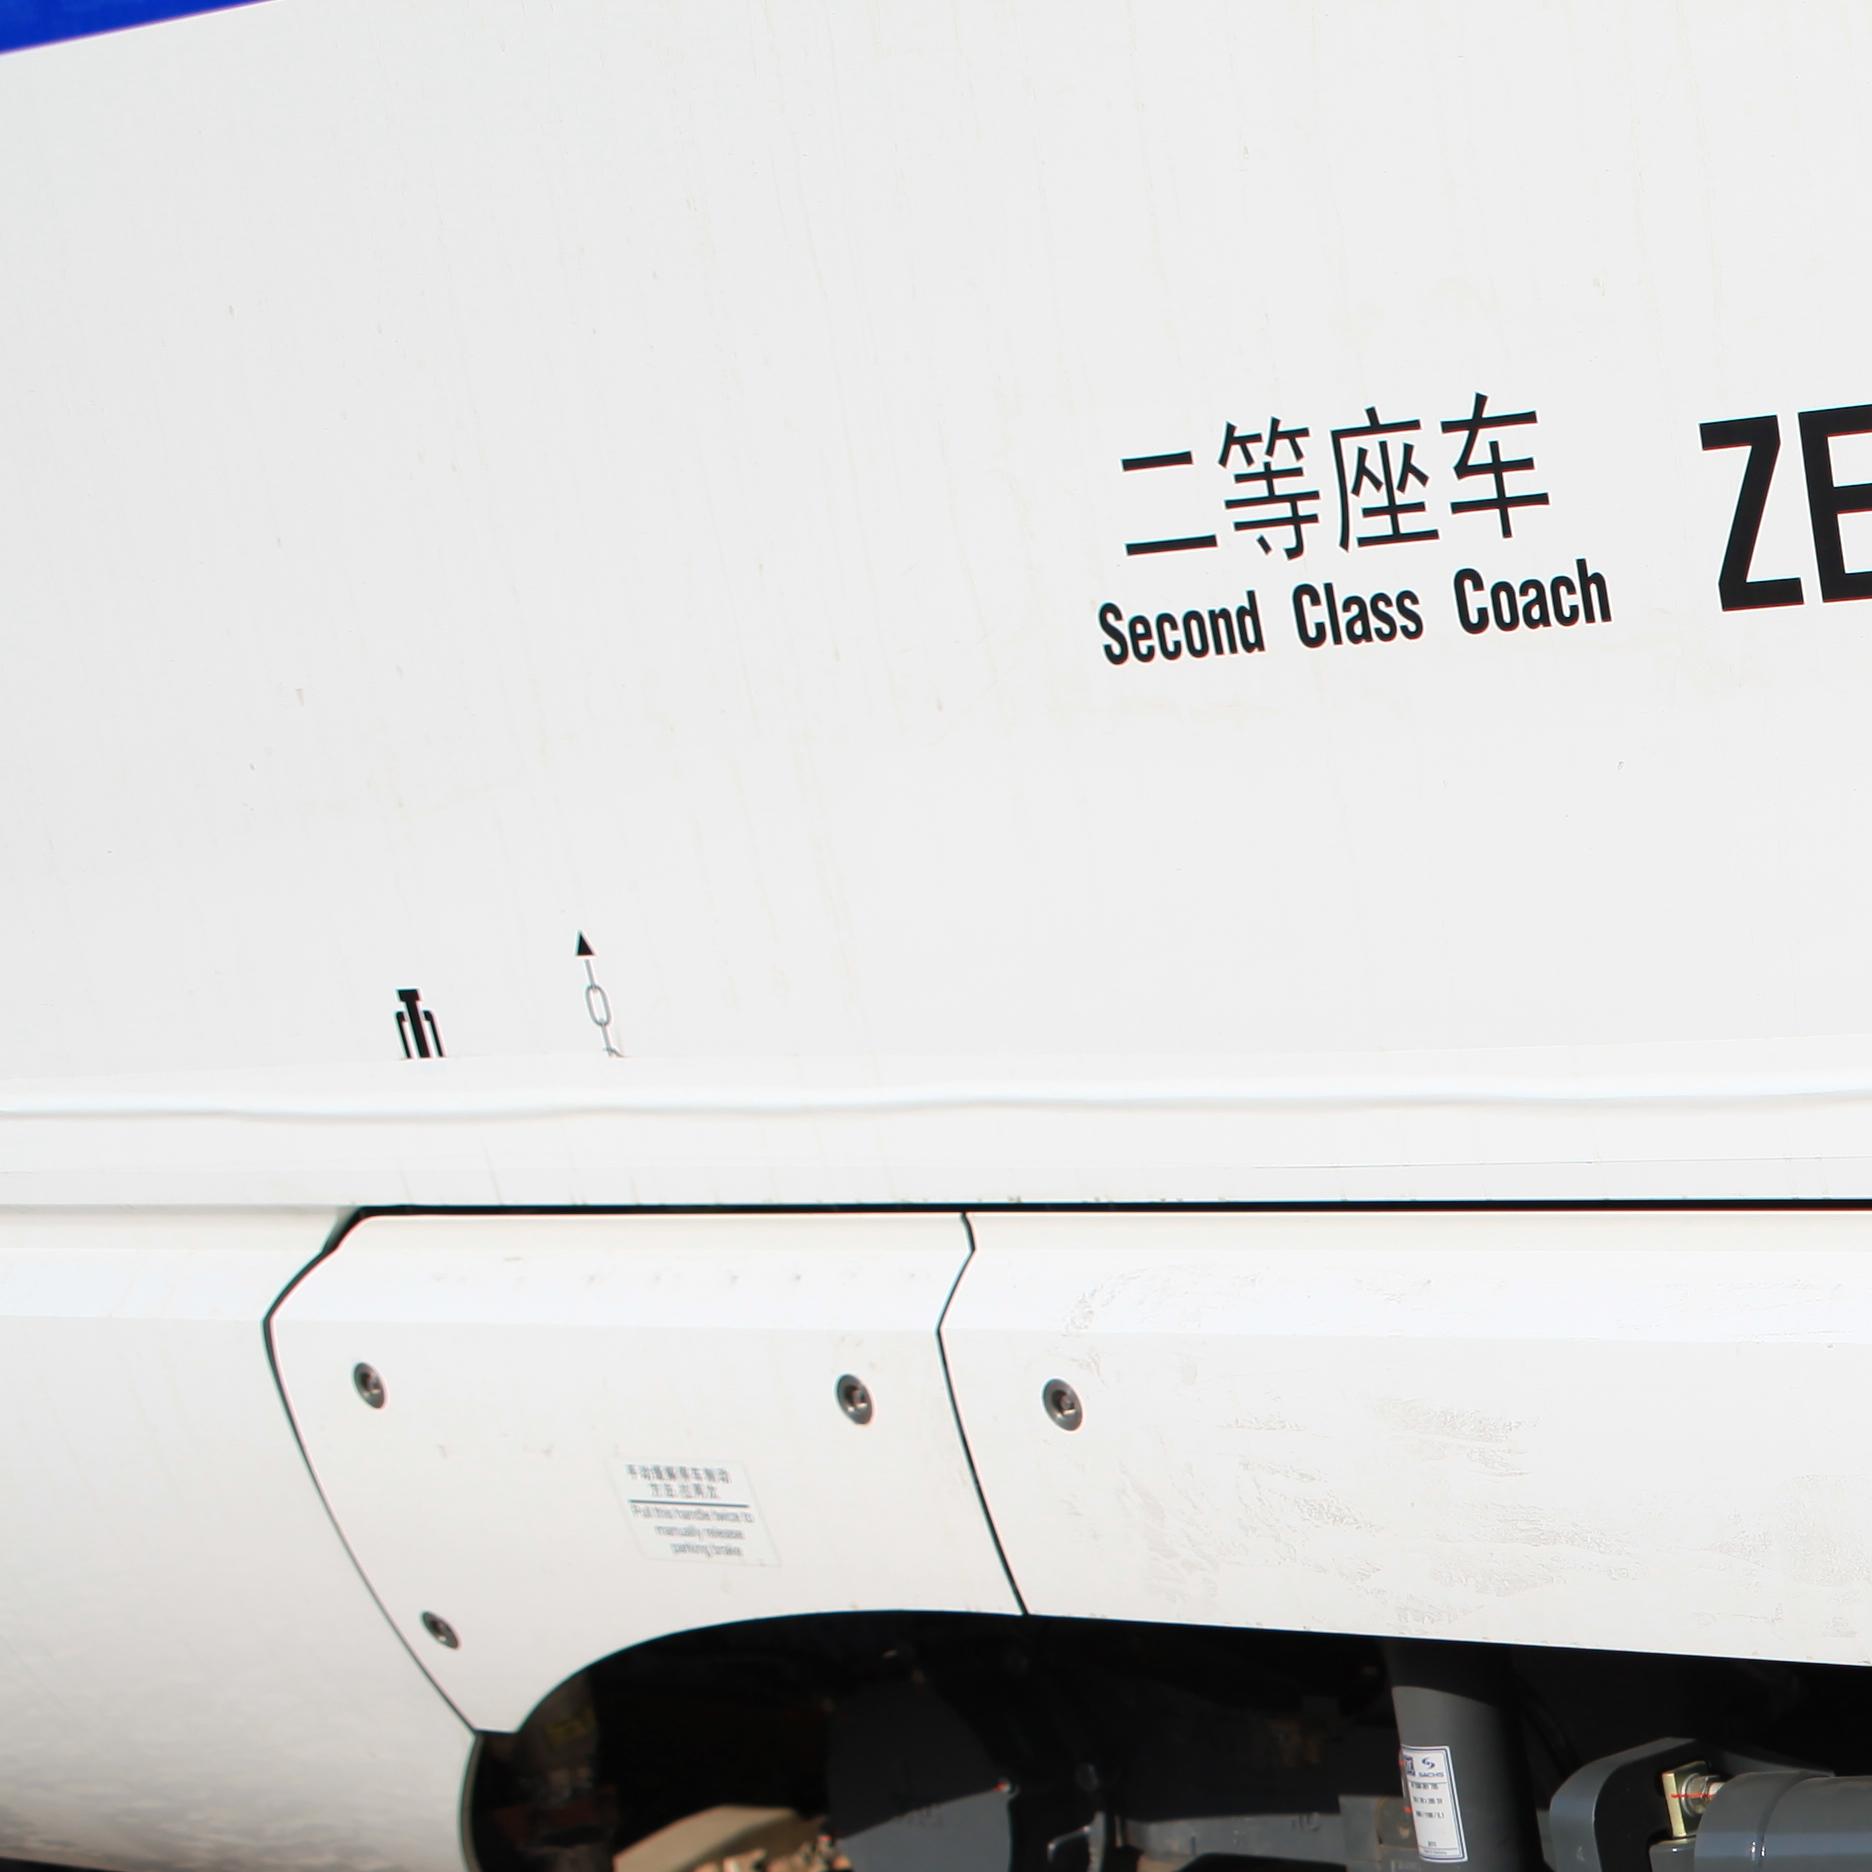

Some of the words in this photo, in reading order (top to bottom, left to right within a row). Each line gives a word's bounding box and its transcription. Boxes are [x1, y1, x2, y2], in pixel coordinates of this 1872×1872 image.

[1120, 392, 1550, 560] 二等座车
[1098, 590, 1265, 665] Second
[1292, 582, 1424, 649] Class
[1453, 558, 1612, 635] Coach
